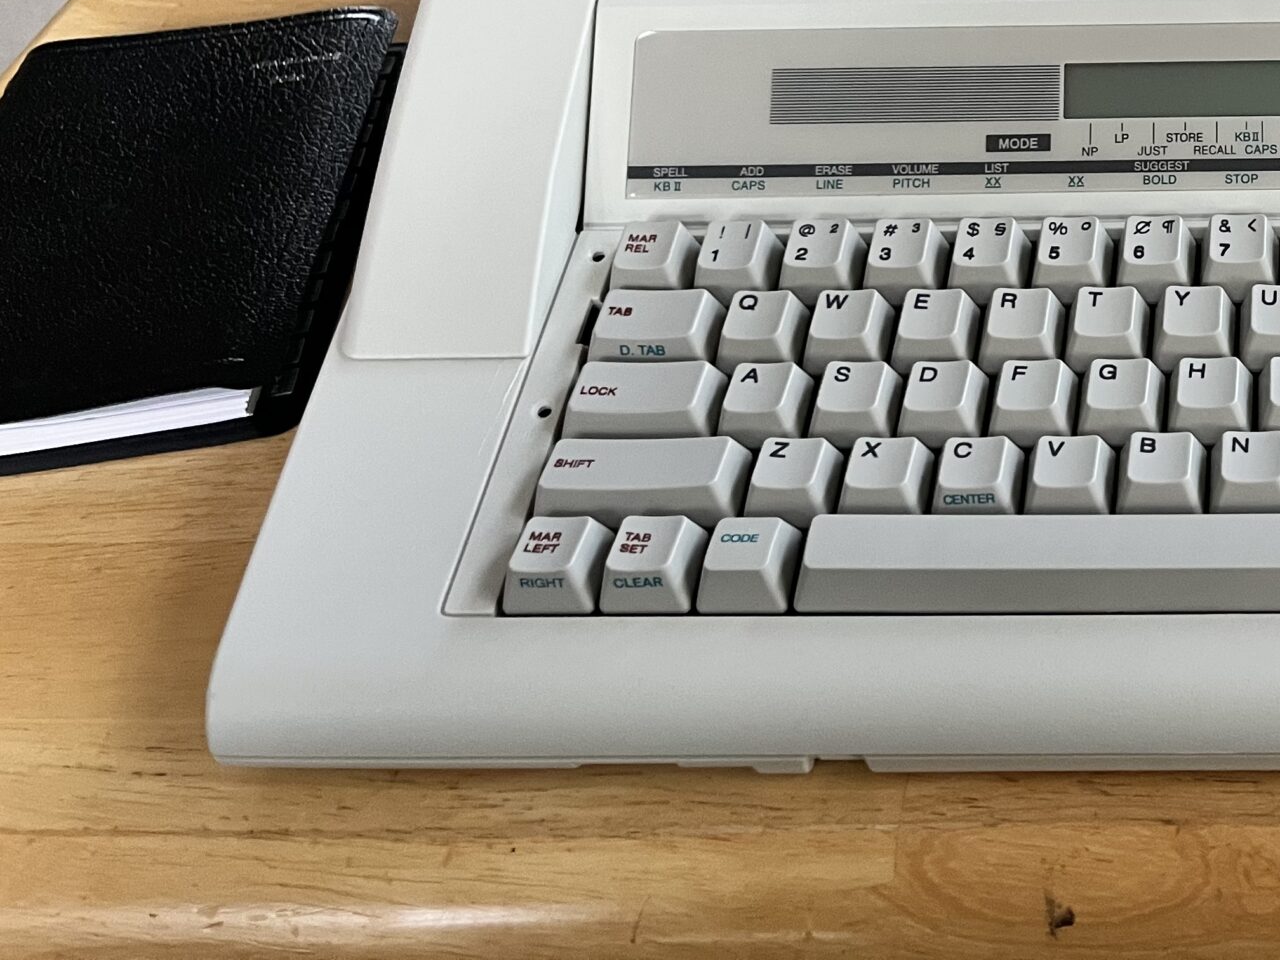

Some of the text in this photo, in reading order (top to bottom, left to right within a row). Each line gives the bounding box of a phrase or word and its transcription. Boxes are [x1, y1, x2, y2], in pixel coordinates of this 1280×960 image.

[1115, 134, 1129, 143] LP
[1167, 133, 1203, 142] STORE
[999, 138, 1037, 149] MODE
[1082, 147, 1098, 156] NP
[1138, 146, 1168, 156] JUST
[1194, 145, 1236, 155] RECALL
[1245, 145, 1277, 154] CAPS
[816, 166, 852, 175] ERASE
[892, 164, 938, 174] VOLUME
[985, 163, 1009, 173] LIST
[1134, 161, 1189, 171] SUGGEST
[654, 168, 688, 177] SPELL
[740, 167, 764, 176] ADD
[816, 179, 843, 189] LINE
[893, 178, 930, 188] PITCH
[1143, 175, 1176, 185] BOLD
[1225, 174, 1258, 184] STOP
[732, 180, 765, 190] CAPS
[628, 234, 657, 242] MAR
[625, 244, 648, 253] REL
[739, 295, 758, 310] Q
[826, 294, 848, 309] W
[914, 294, 930, 309] E
[1001, 293, 1017, 308] R
[1089, 292, 1103, 307] T
[1175, 291, 1190, 306] Y
[1262, 290, 1277, 305] U
[609, 307, 632, 316] TAB
[638, 345, 665, 356] TAB
[741, 368, 758, 383] A
[835, 367, 850, 382] S
[919, 367, 937, 382] D
[1012, 366, 1027, 380] F
[1099, 364, 1117, 380] G
[1189, 363, 1205, 378] H
[580, 386, 617, 396] LOCK
[770, 442, 789, 458] Z
[861, 442, 881, 457] X
[954, 442, 972, 458] C
[1049, 441, 1065, 456] V
[1140, 438, 1155, 453] B
[1232, 437, 1249, 453] N
[554, 459, 595, 468] SHIFT
[943, 494, 995, 505] CENTER
[529, 532, 562, 541] MAR
[626, 532, 651, 542] TAB
[721, 534, 759, 542] CODE
[524, 544, 560, 553] LEFT
[620, 544, 648, 553] SET
[520, 578, 563, 587] RIGHT
[613, 577, 663, 588] CLEAR
